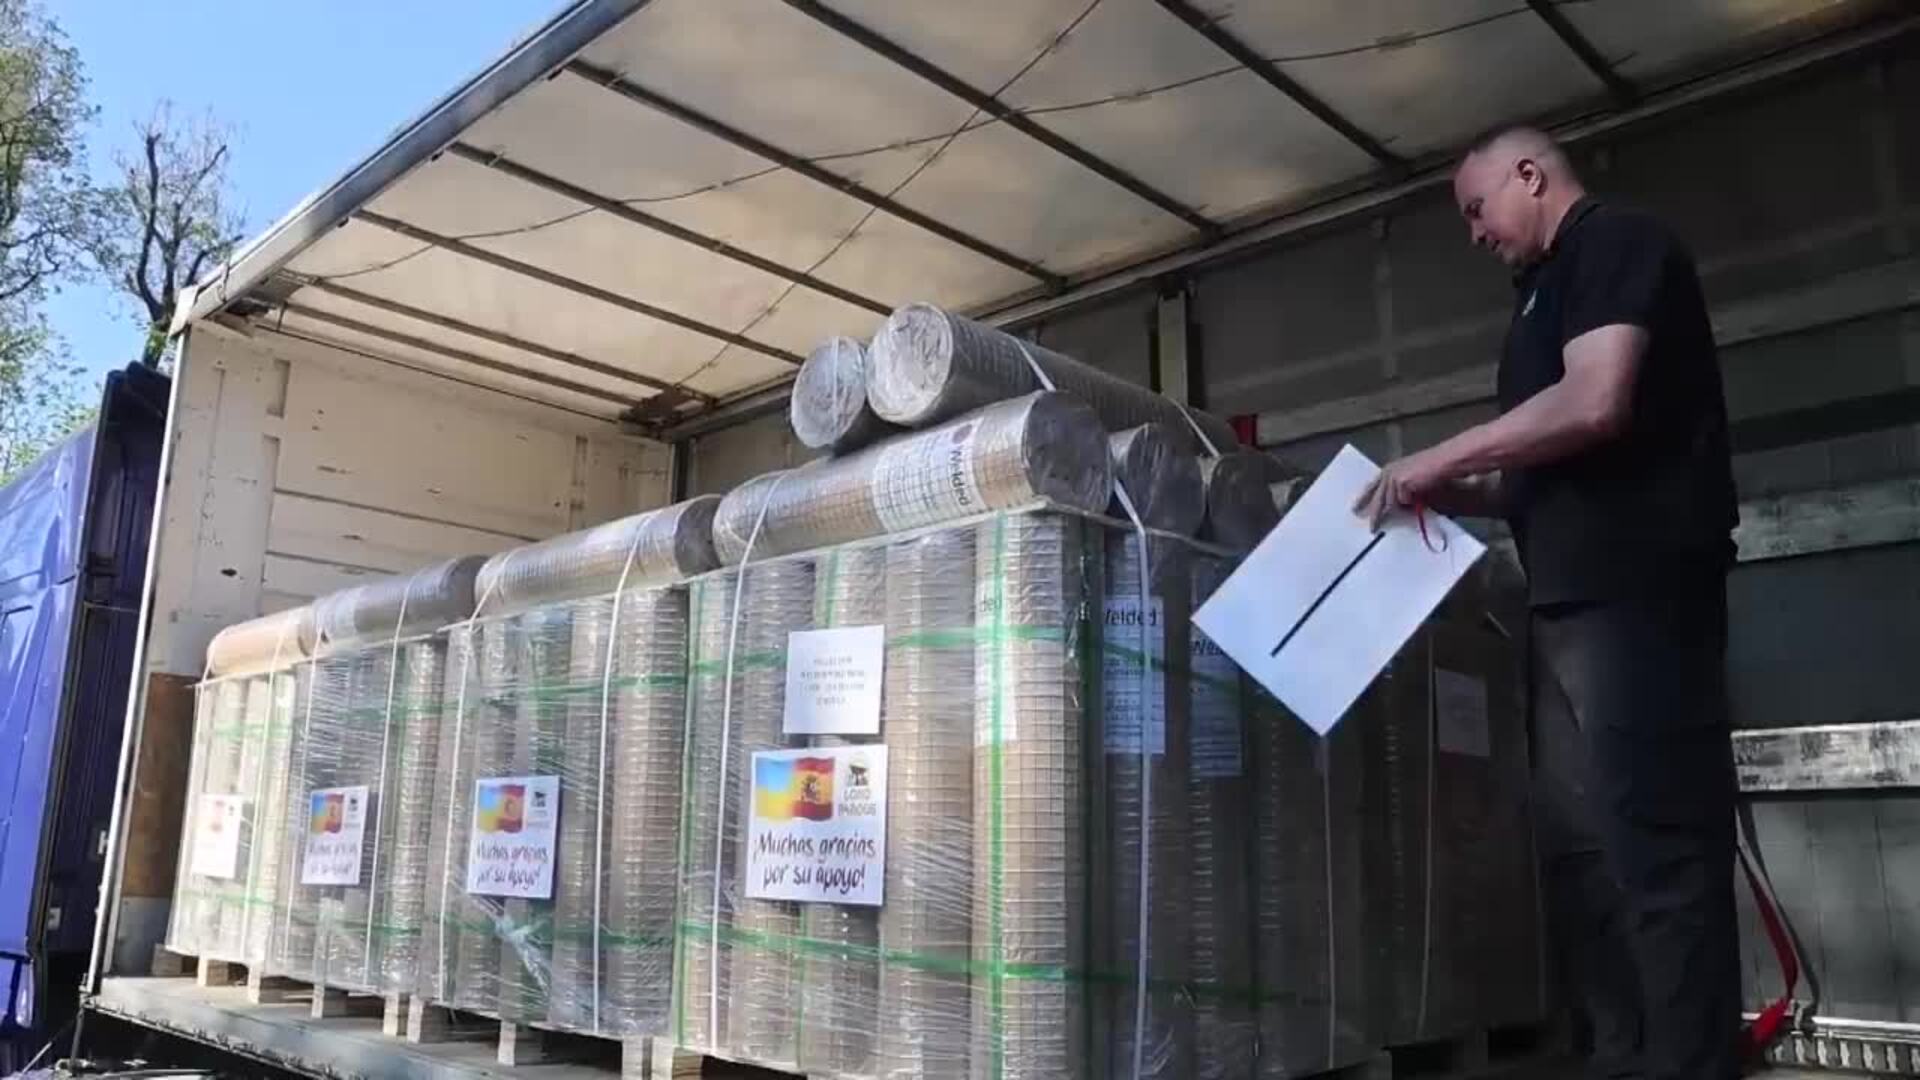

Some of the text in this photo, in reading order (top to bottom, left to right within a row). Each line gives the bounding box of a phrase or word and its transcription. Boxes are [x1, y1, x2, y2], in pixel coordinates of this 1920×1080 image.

[950, 446, 972, 506] Welded
[753, 829, 876, 864] ¡Muchas gracias
[763, 864, 865, 895] por su apoyo!
